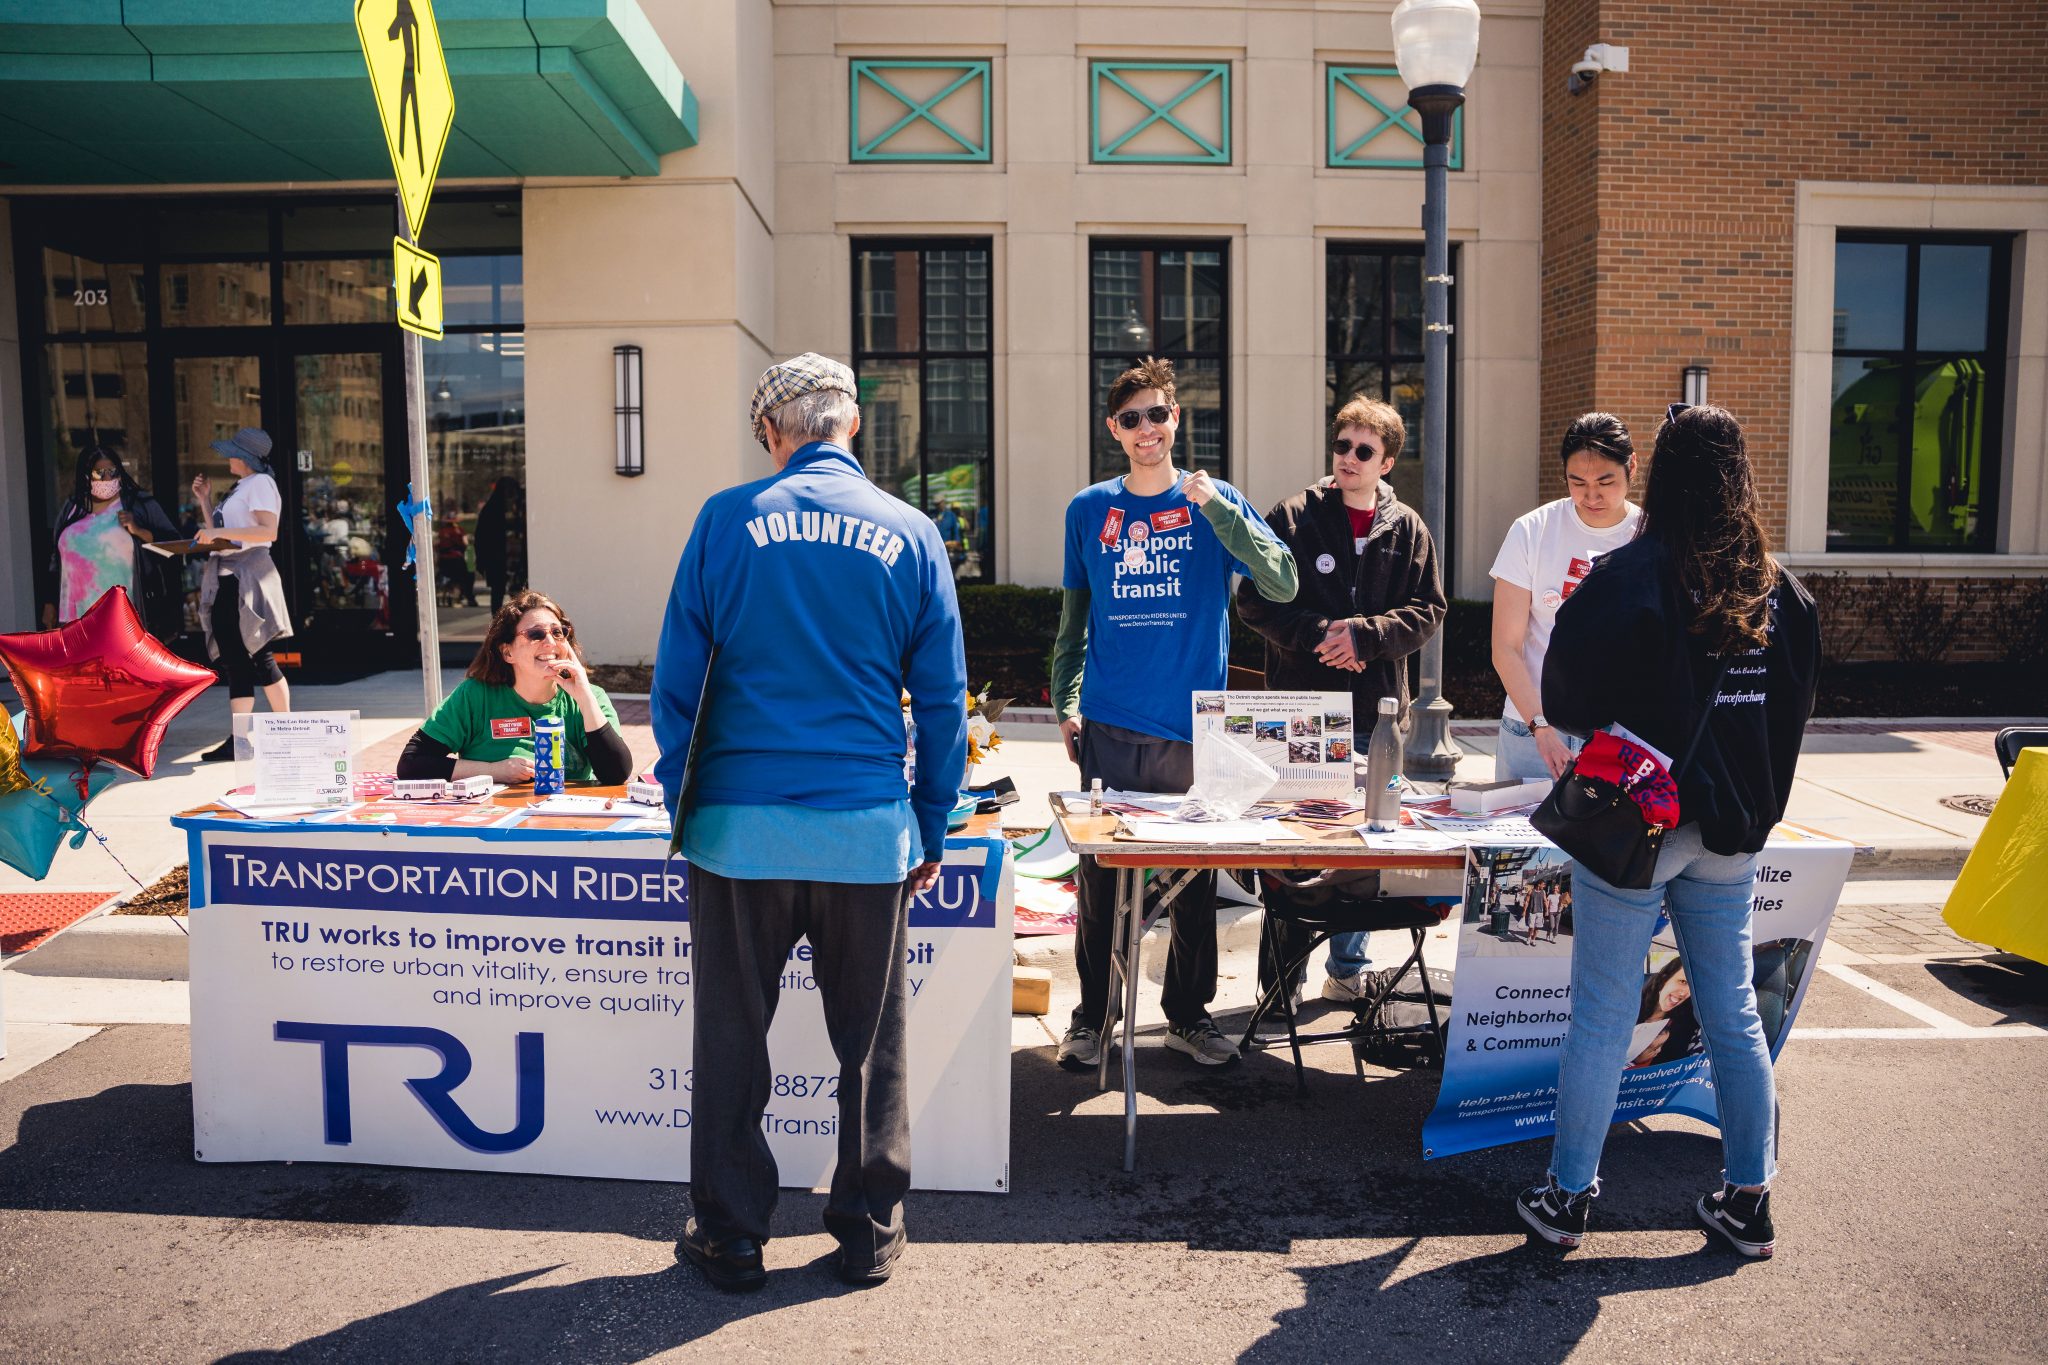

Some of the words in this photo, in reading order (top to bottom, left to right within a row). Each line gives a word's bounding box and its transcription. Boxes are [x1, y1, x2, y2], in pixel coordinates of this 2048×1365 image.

[73, 289, 108, 306] 203
[745, 511, 905, 568] VOLUNTEER
[1112, 532, 1193, 554] support
[1114, 554, 1180, 580] public
[1111, 576, 1182, 599] transit
[225, 853, 558, 900] TRANSPORTATION
[573, 865, 690, 904] RIDER
[908, 874, 980, 918] RU)
[261, 921, 310, 943] TRU
[319, 926, 400, 948] works
[409, 927, 437, 950] to
[446, 928, 566, 956] improve
[575, 934, 664, 957] transit
[271, 951, 295, 971] to
[302, 953, 385, 974] restore
[393, 955, 464, 978] urban
[472, 959, 557, 984] vitality,
[565, 967, 648, 985] ensure
[433, 987, 482, 1007] and
[489, 988, 591, 1012] improve
[600, 992, 685, 1017] quality
[1466, 1038, 1477, 1052] &
[1629, 1063, 1682, 1082] Involved
[1684, 1057, 1711, 1072] with
[273, 1020, 545, 1155] TRU
[1458, 1096, 1491, 1108] Help
[1493, 1091, 1531, 1103] make
[1534, 1088, 1545, 1097] it
[1618, 1087, 1637, 1095] rofit
[1638, 1083, 1668, 1093] transit
[1458, 1104, 1524, 1118] Transportation
[1525, 1100, 1553, 1108] Riders
